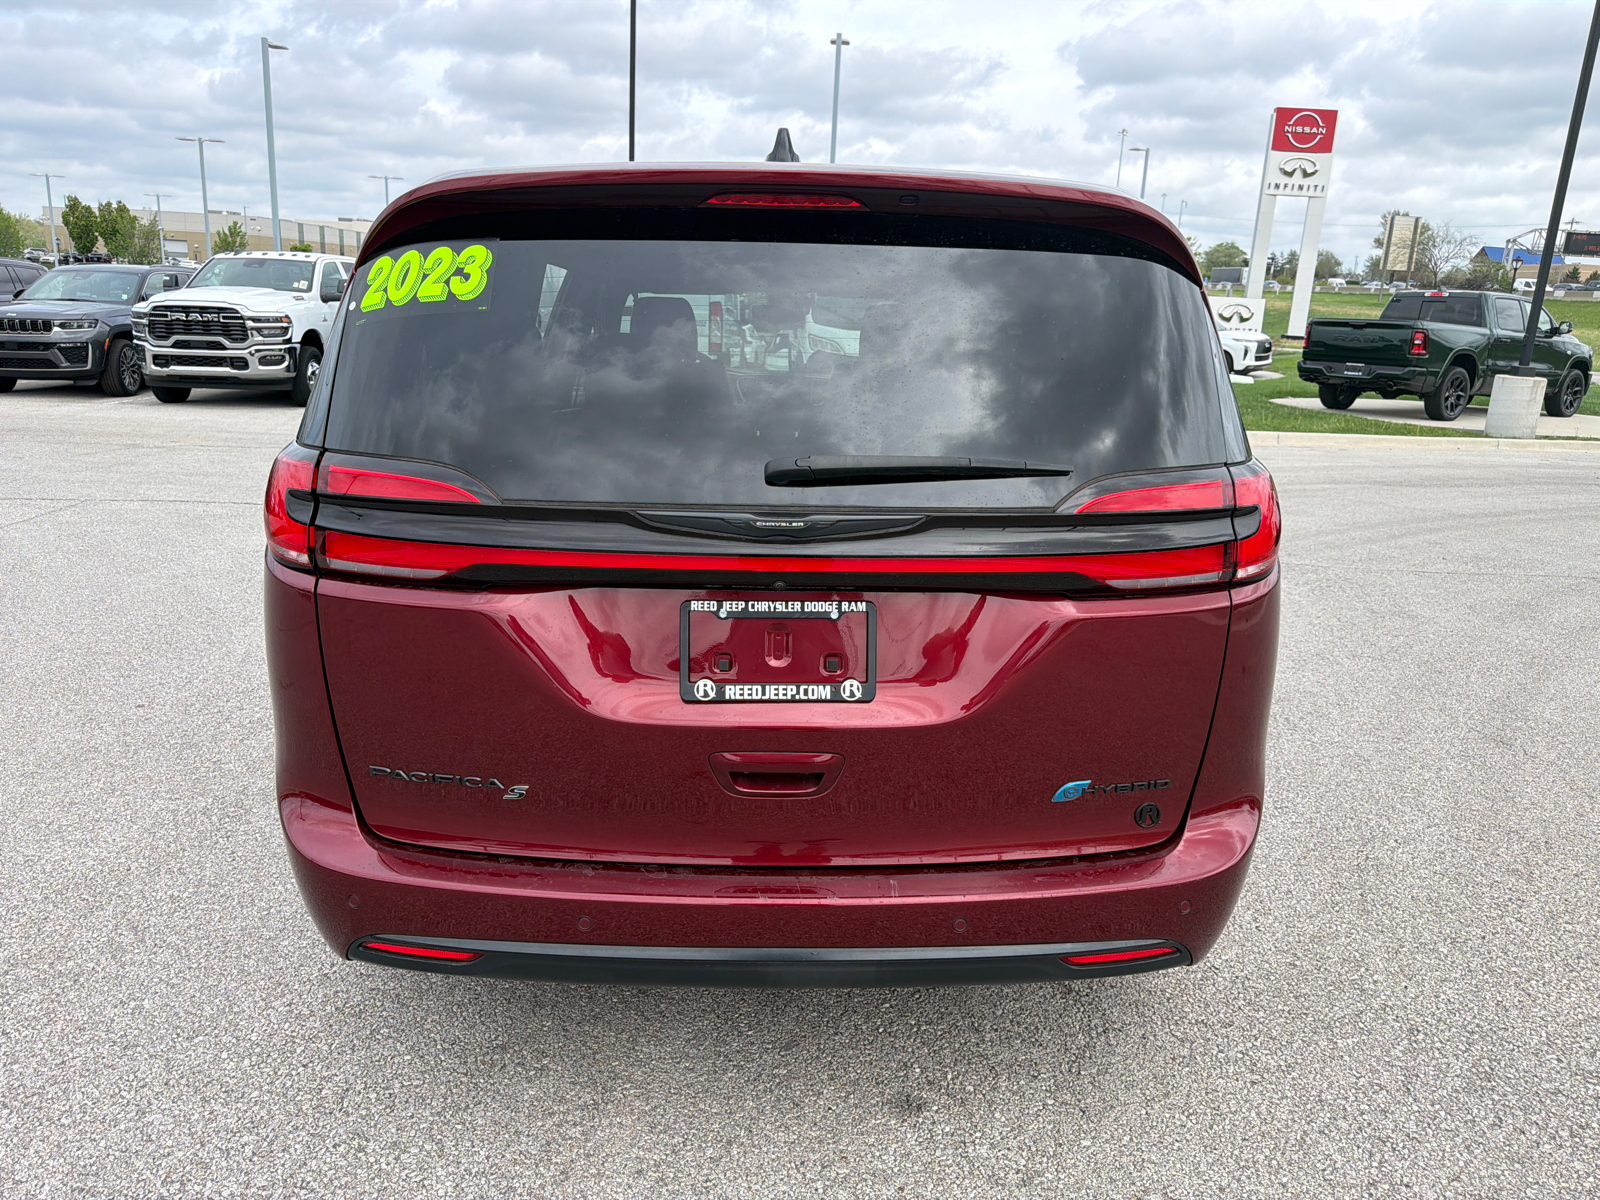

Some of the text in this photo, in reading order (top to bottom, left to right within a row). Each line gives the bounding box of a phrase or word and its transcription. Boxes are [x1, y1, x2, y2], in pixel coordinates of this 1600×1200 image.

[1284, 125, 1326, 134] NISSAN
[1267, 182, 1325, 192] INFINITI
[360, 244, 493, 313] 2023
[169, 312, 219, 322] RAM
[690, 600, 867, 612] REED JEEP CHRYSLER DODGE RAM
[725, 685, 831, 700] REEDJEEP.COM
[369, 765, 530, 800] PACIFICA S
